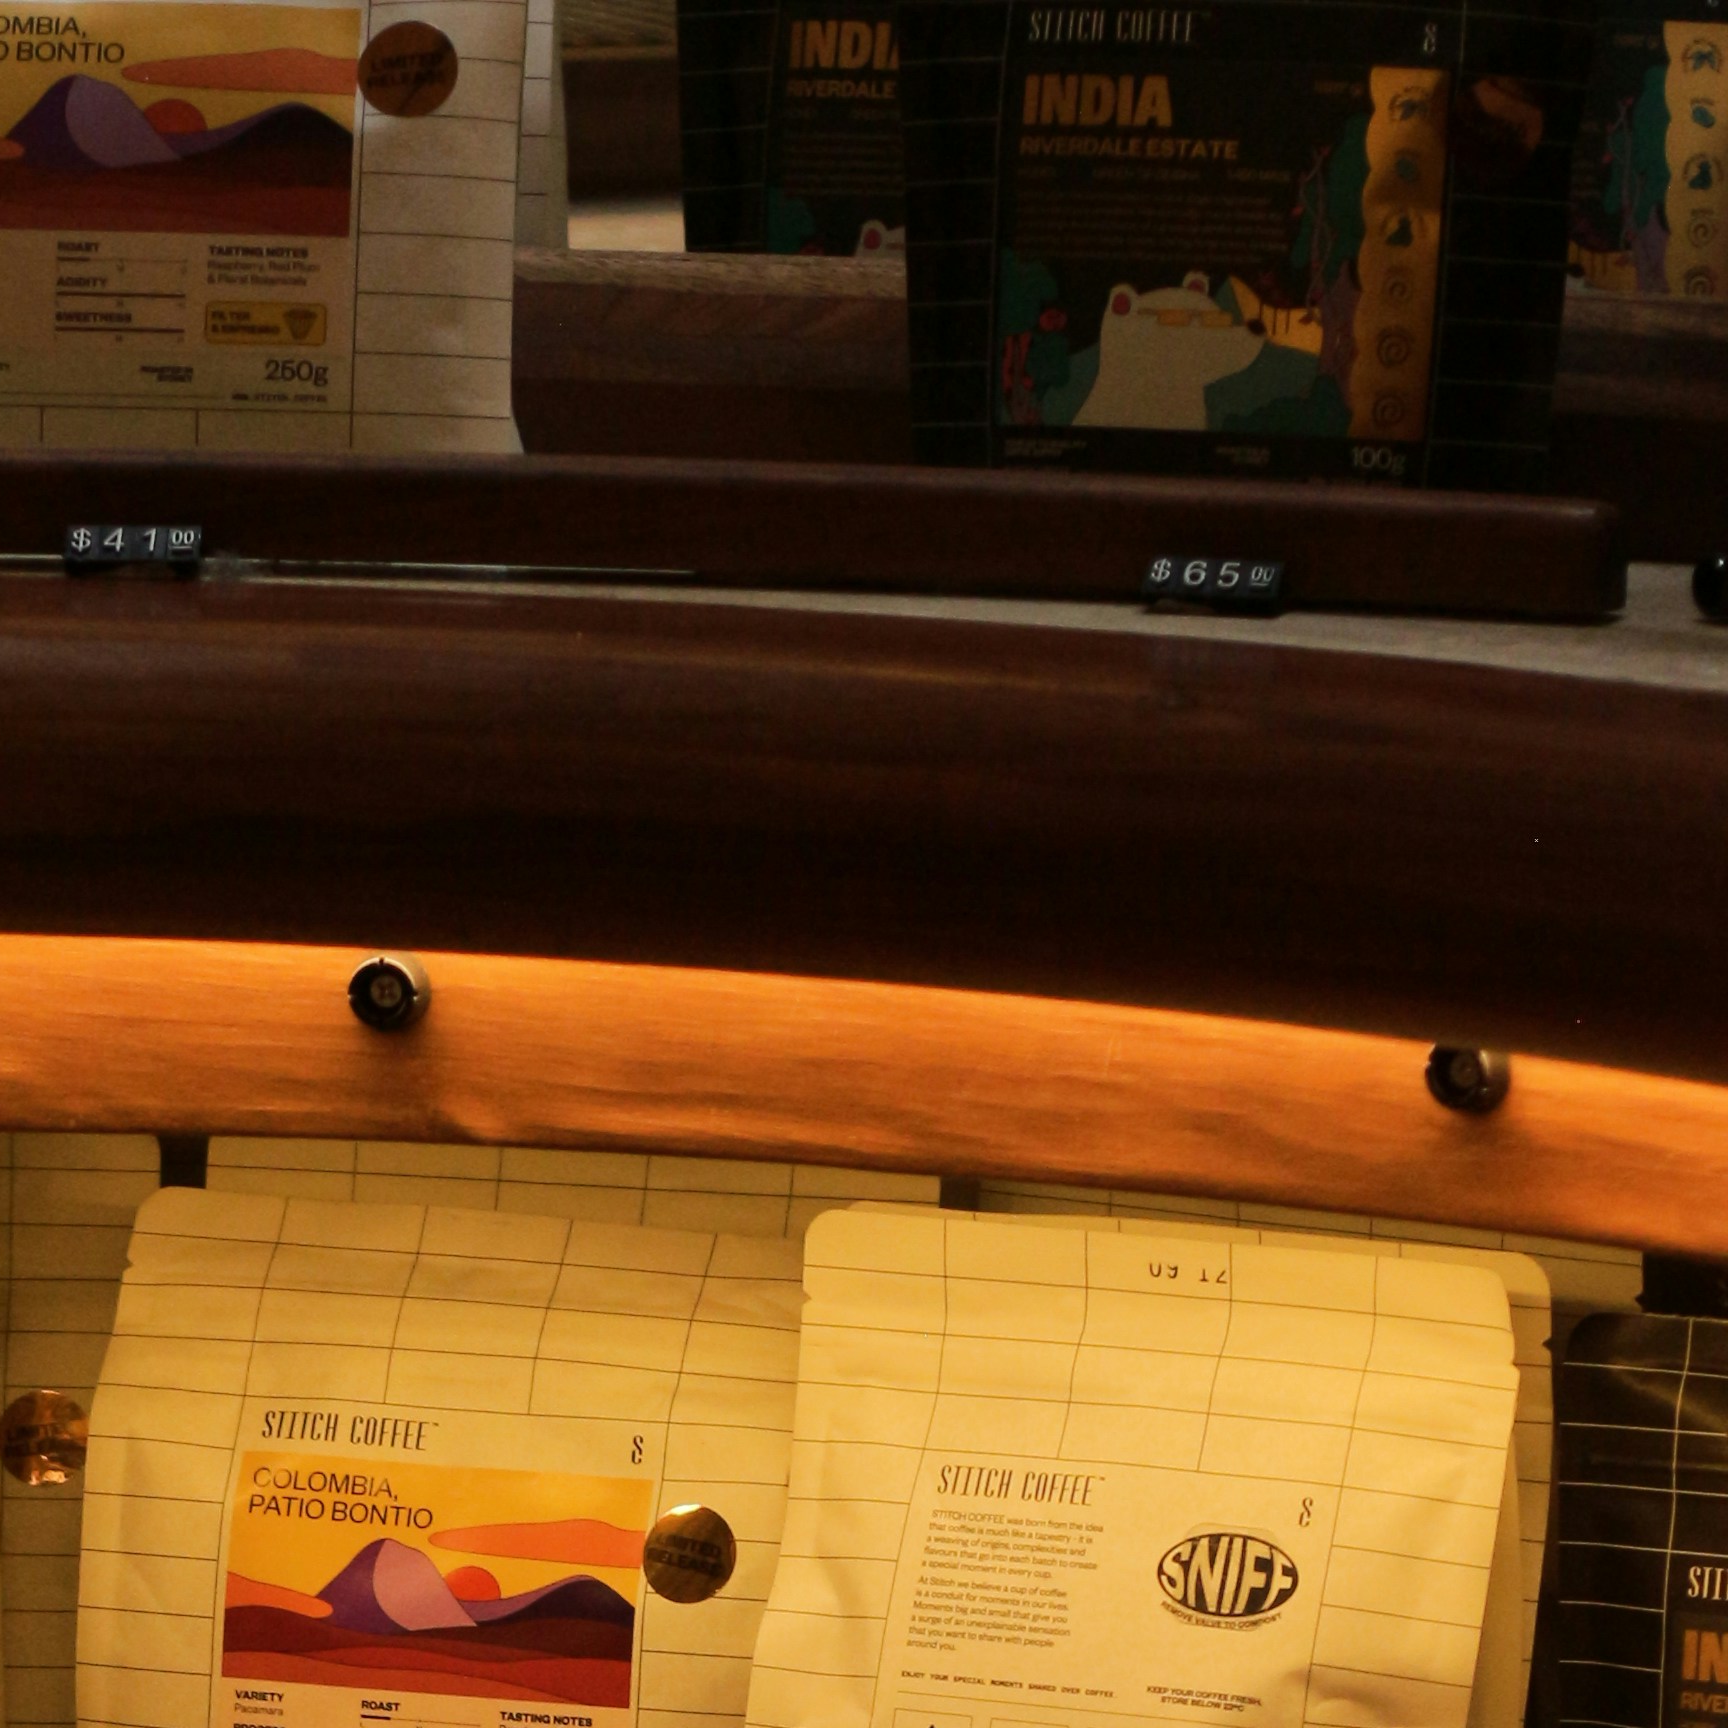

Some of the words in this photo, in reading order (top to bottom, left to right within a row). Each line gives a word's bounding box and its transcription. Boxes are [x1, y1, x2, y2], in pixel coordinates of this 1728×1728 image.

[1029, 9, 1105, 43] STITCH
[1117, 9, 1194, 43] COFFEE
[16, 41, 125, 64] BONTIO
[1024, 73, 1173, 127] INDIA
[1146, 139, 1240, 160] ESTATE
[265, 360, 329, 386] 250g
[1351, 446, 1406, 476] 100g
[262, 1410, 336, 1442] STITCH
[350, 1415, 427, 1451] COFFEE
[253, 1467, 398, 1500] COLOMBIA,
[938, 1465, 1012, 1498] STITCH
[1022, 1472, 1094, 1506] COFFEE
[249, 1495, 325, 1519] PATIO
[332, 1501, 433, 1529] BONTIO
[1160, 1535, 1293, 1613] SNIFF
[235, 1690, 284, 1702] VARIETY
[361, 1700, 400, 1711] ROAST
[500, 1712, 550, 1724] TASTING
[553, 1716, 593, 1727] NOTES
